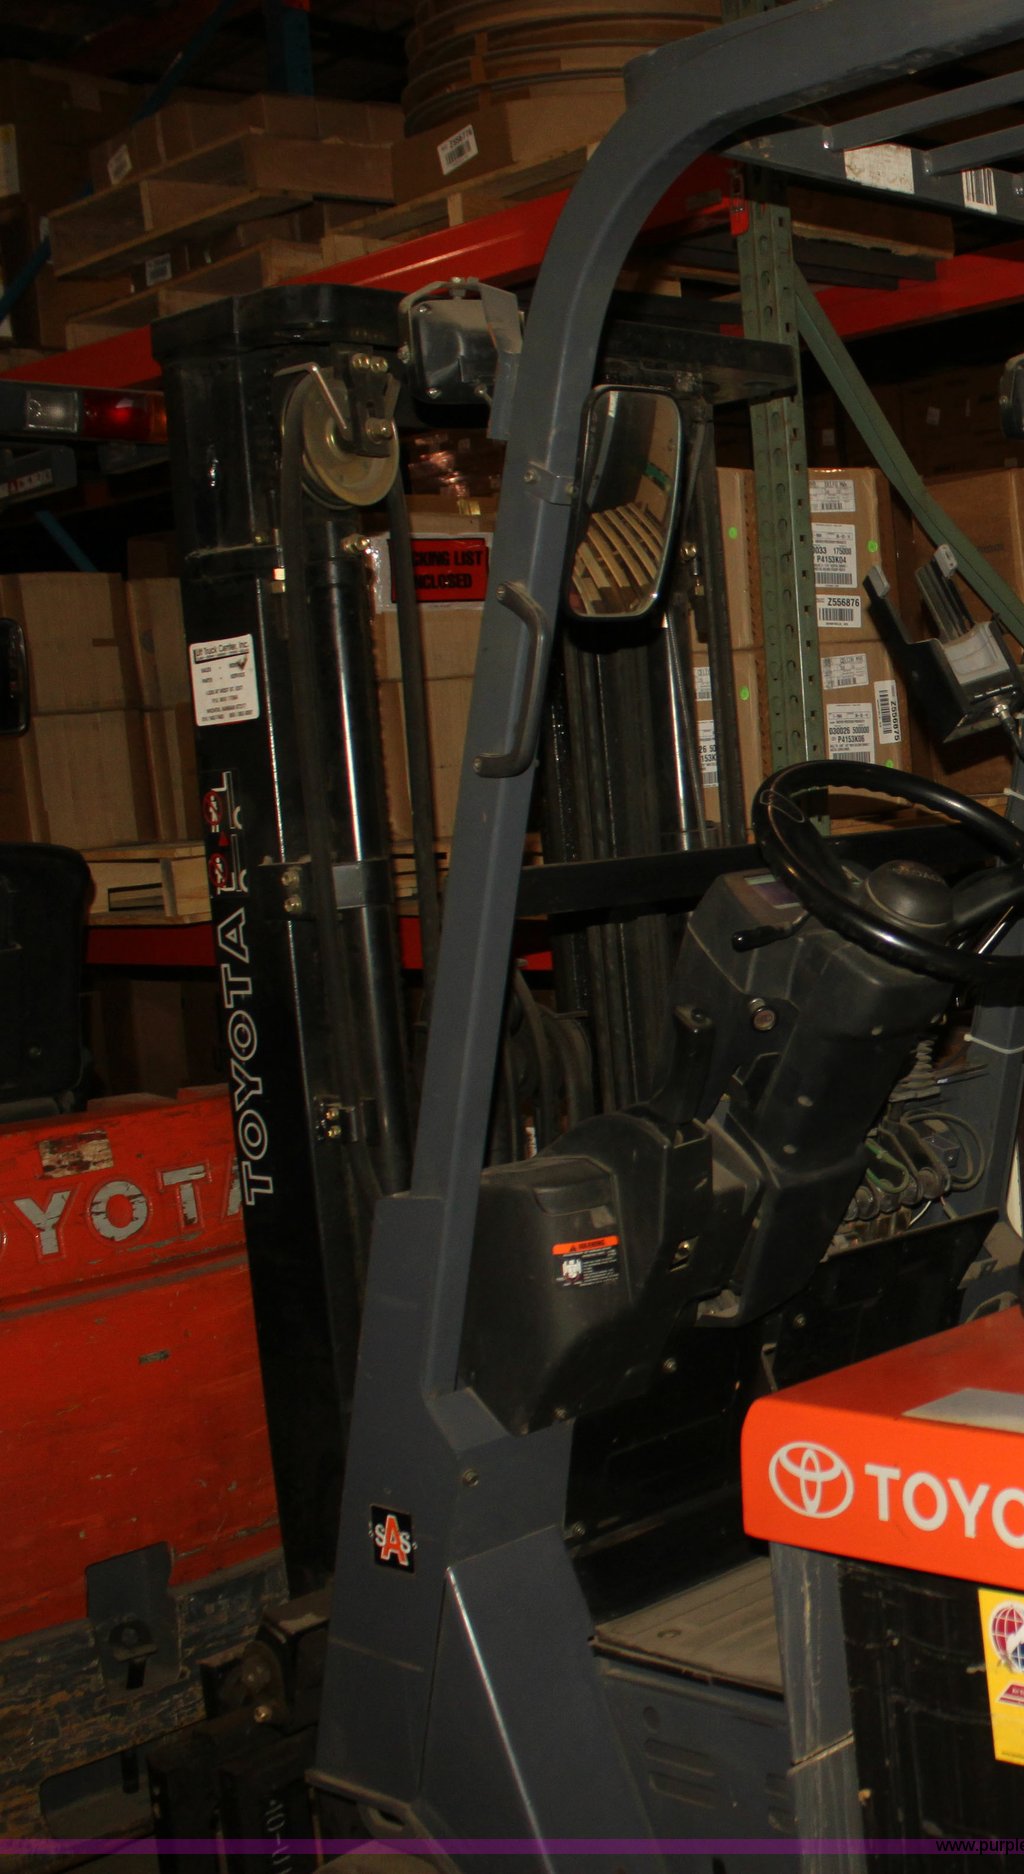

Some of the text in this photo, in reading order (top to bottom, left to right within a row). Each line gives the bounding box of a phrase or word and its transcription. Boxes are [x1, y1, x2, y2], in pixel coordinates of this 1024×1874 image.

[413, 549, 482, 566] CKING LIST
[415, 574, 472, 589] NCLOSED
[827, 597, 860, 607] Z556876
[217, 906, 274, 1206] TOYOTA
[13, 1158, 242, 1256] YOT
